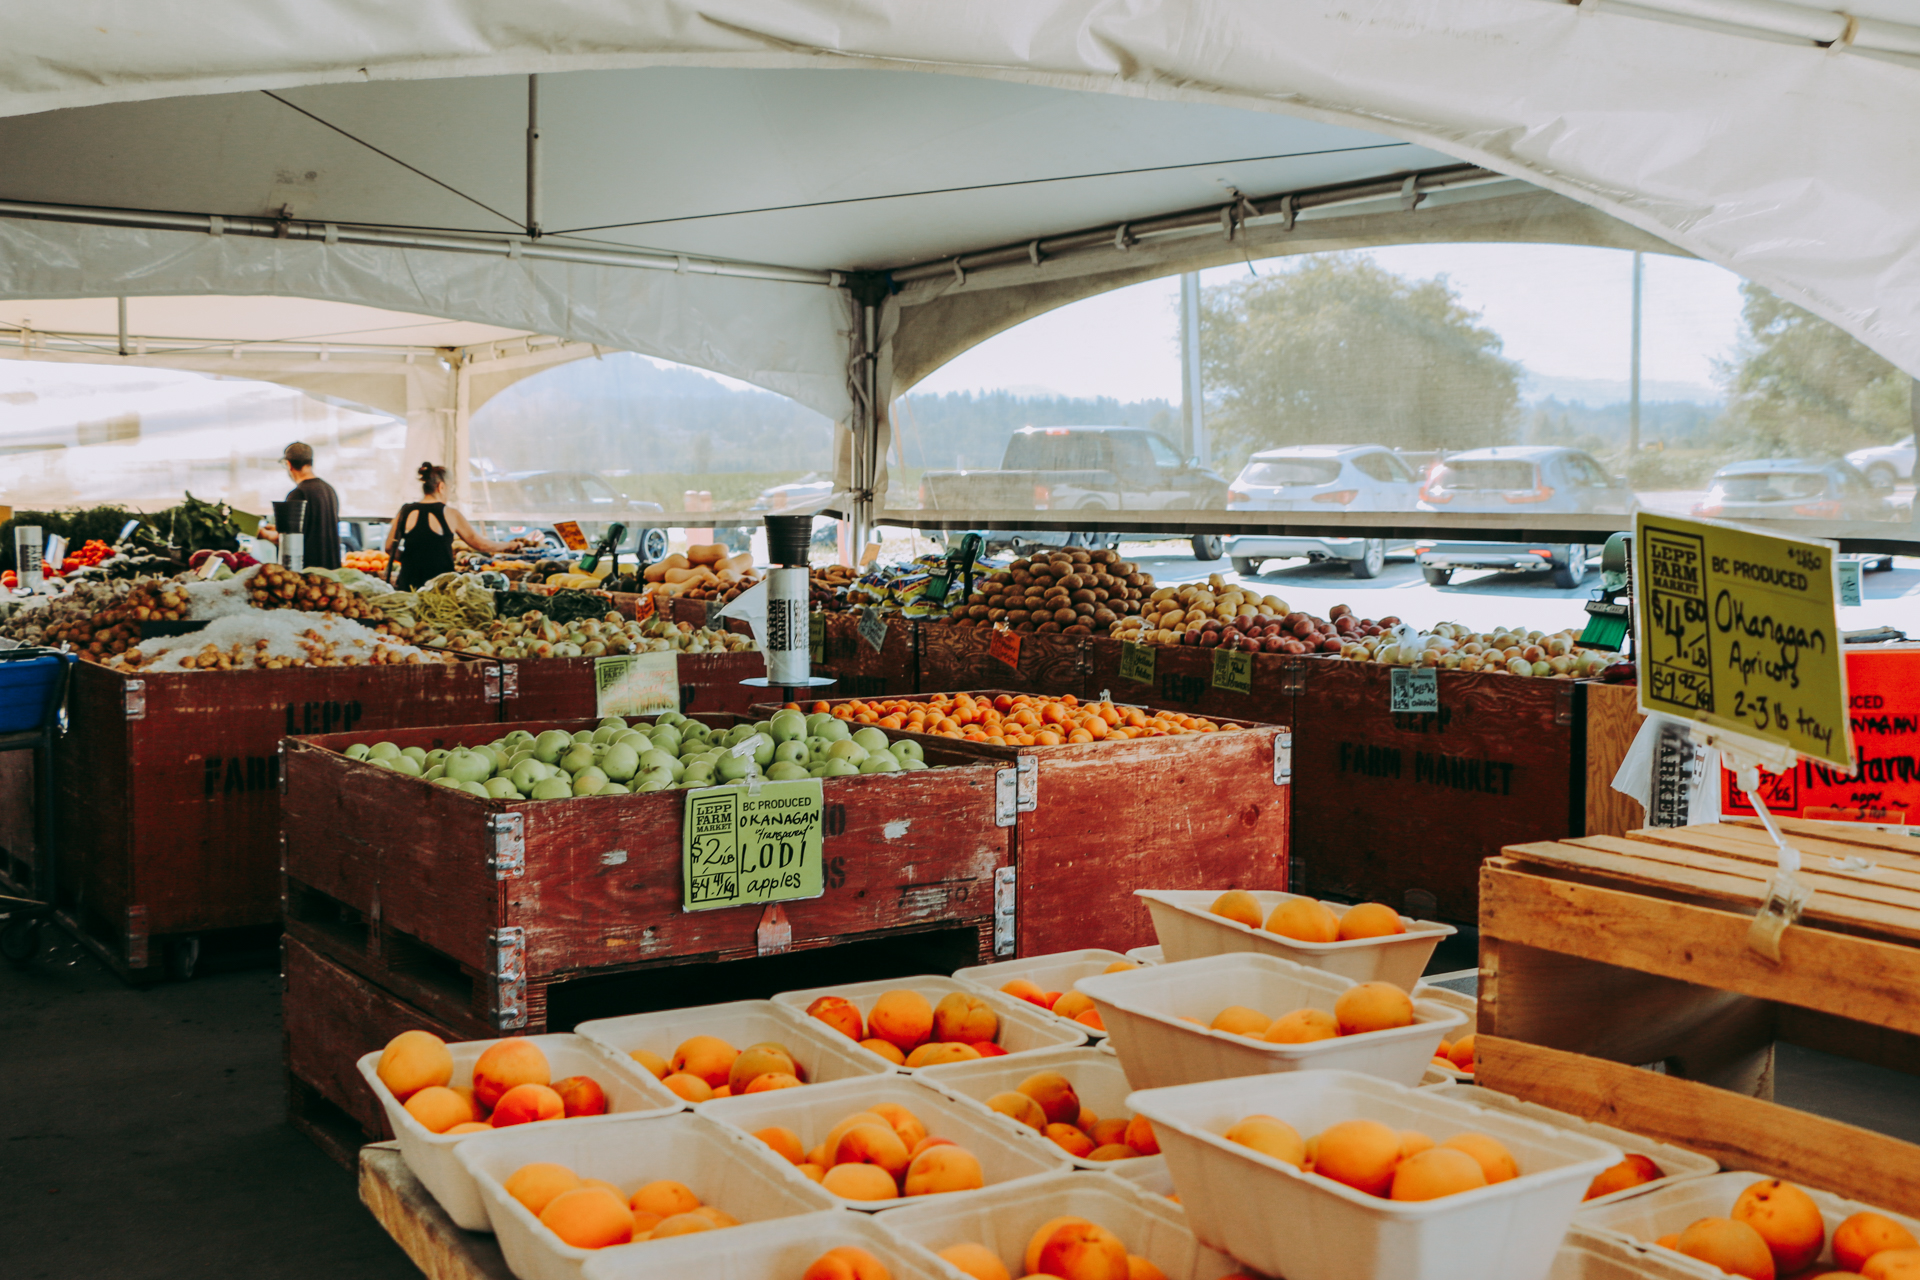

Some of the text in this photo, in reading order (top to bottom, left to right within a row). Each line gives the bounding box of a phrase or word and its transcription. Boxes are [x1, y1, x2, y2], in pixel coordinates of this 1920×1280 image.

[1651, 544, 1697, 565] LEPP
[1652, 559, 1698, 583] FARM
[1712, 556, 1808, 591] BC PRODUCED
[1653, 576, 1698, 595] MARKET
[286, 701, 362, 735] LEPP
[1734, 690, 1833, 756] 2-3 lb tray
[1340, 742, 1514, 795] FARM MARKET
[696, 804, 732, 815] LEPP
[743, 797, 811, 811] BC PRODUCED
[696, 813, 732, 825] FARM
[696, 823, 732, 833] MARKET
[740, 810, 819, 827] OKANAGAN
[740, 841, 806, 874] LODI
[747, 872, 801, 898] apples
